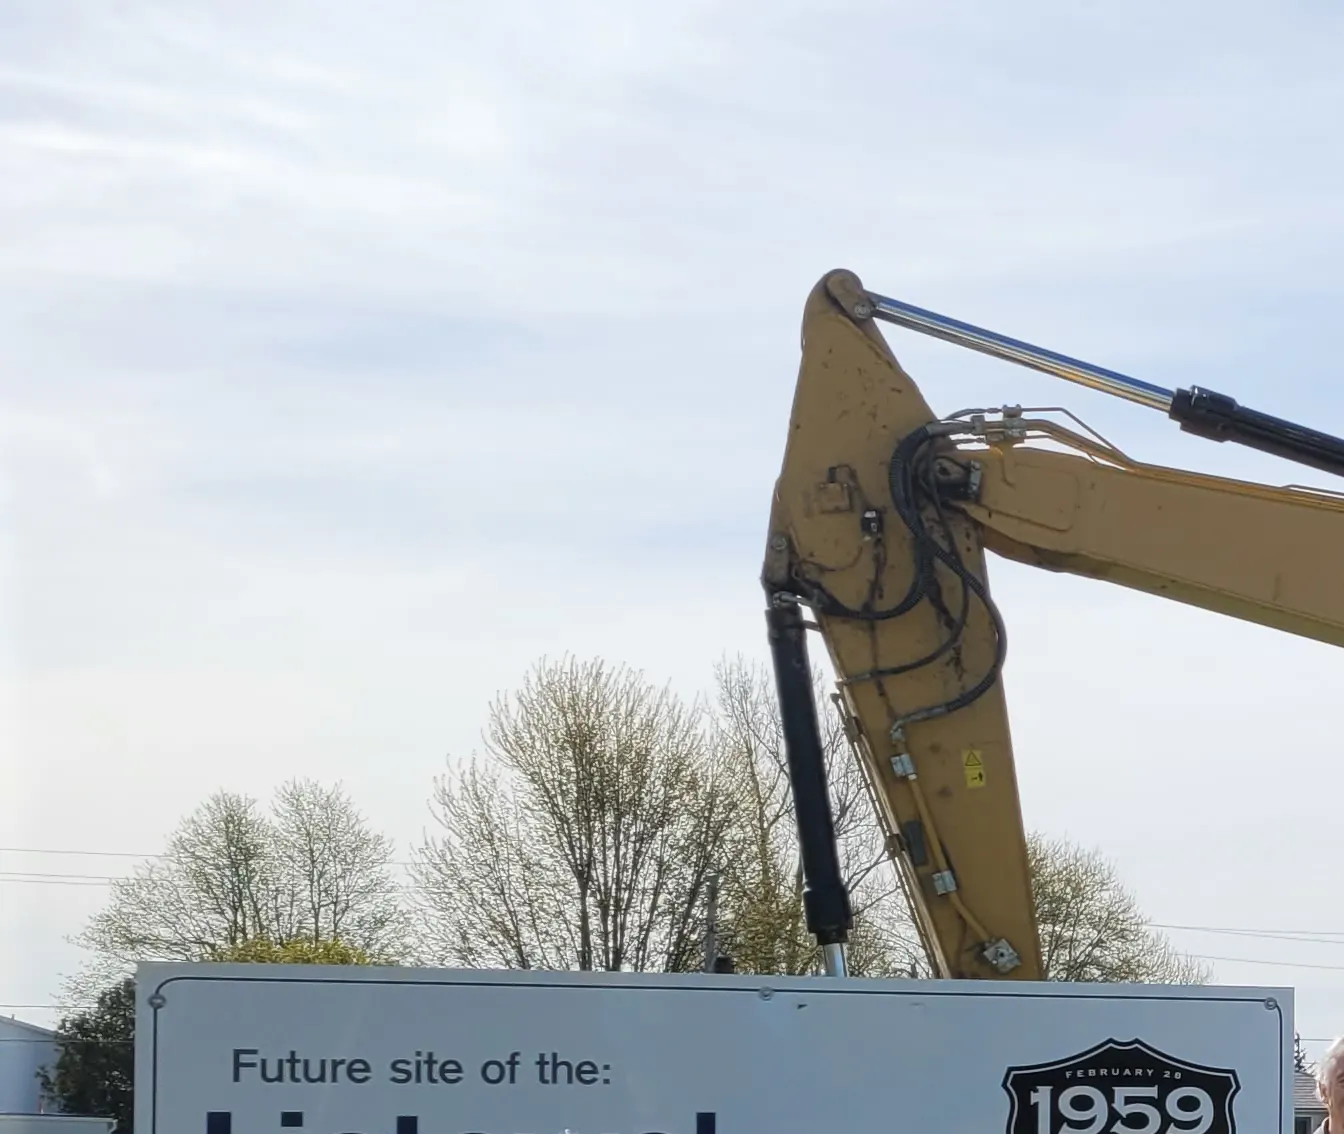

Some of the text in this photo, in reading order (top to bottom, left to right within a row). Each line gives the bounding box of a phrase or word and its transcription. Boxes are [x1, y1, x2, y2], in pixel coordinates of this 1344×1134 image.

[232, 1049, 612, 1085] Future site of the:
[1066, 1068, 1154, 1080] FEBRUARY
